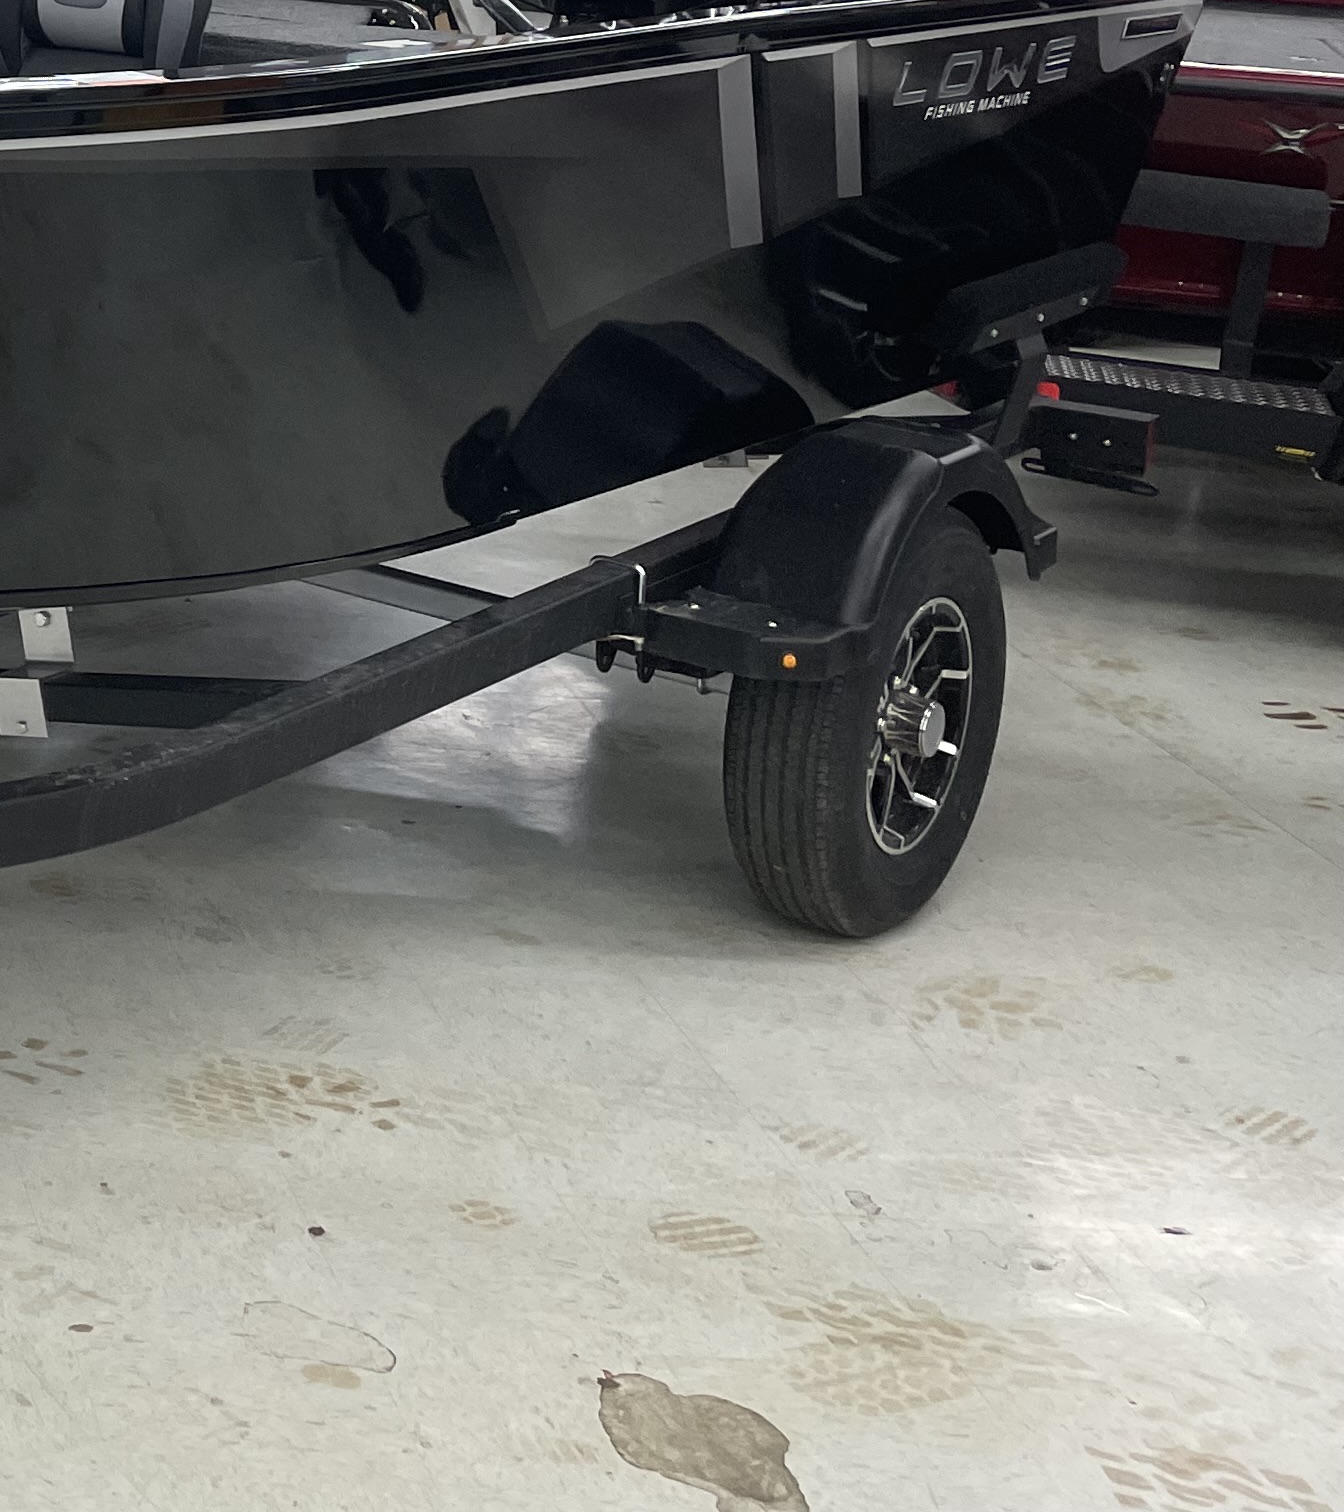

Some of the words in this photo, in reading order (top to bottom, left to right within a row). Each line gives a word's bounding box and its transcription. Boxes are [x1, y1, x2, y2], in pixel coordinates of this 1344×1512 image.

[892, 35, 1077, 107] LOWE
[923, 99, 975, 121] FISHING
[977, 90, 1032, 113] MACHINE
